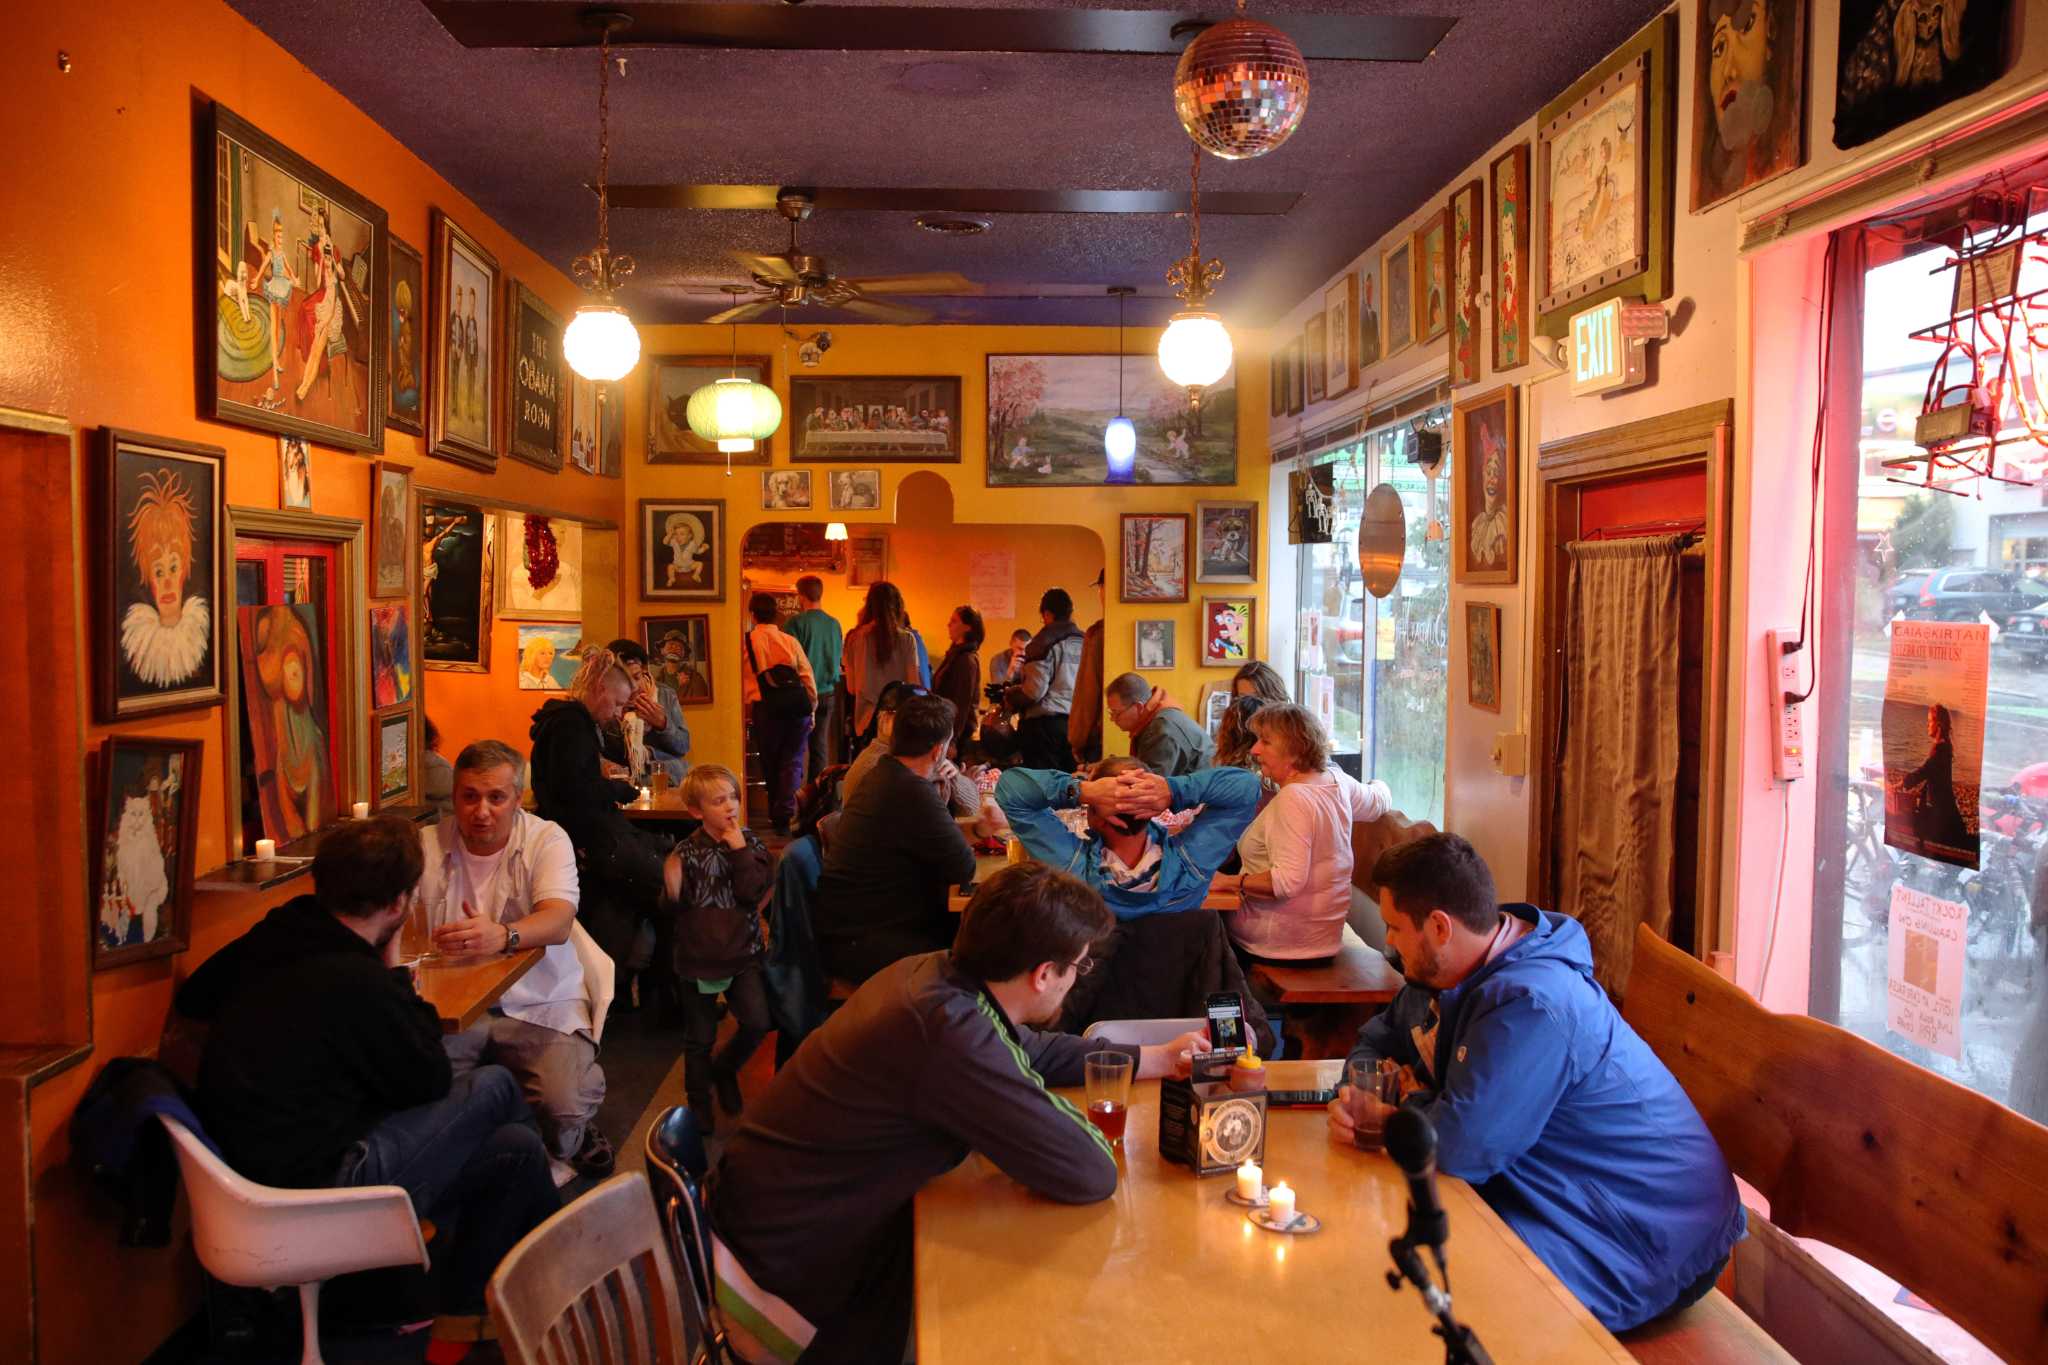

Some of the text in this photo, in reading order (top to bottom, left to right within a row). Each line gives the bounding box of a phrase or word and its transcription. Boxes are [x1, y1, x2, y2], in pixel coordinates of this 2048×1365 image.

[532, 332, 547, 360] THE
[1575, 304, 1613, 383] EXIT
[519, 356, 556, 402] OBAMA
[524, 400, 550, 431] ROOM
